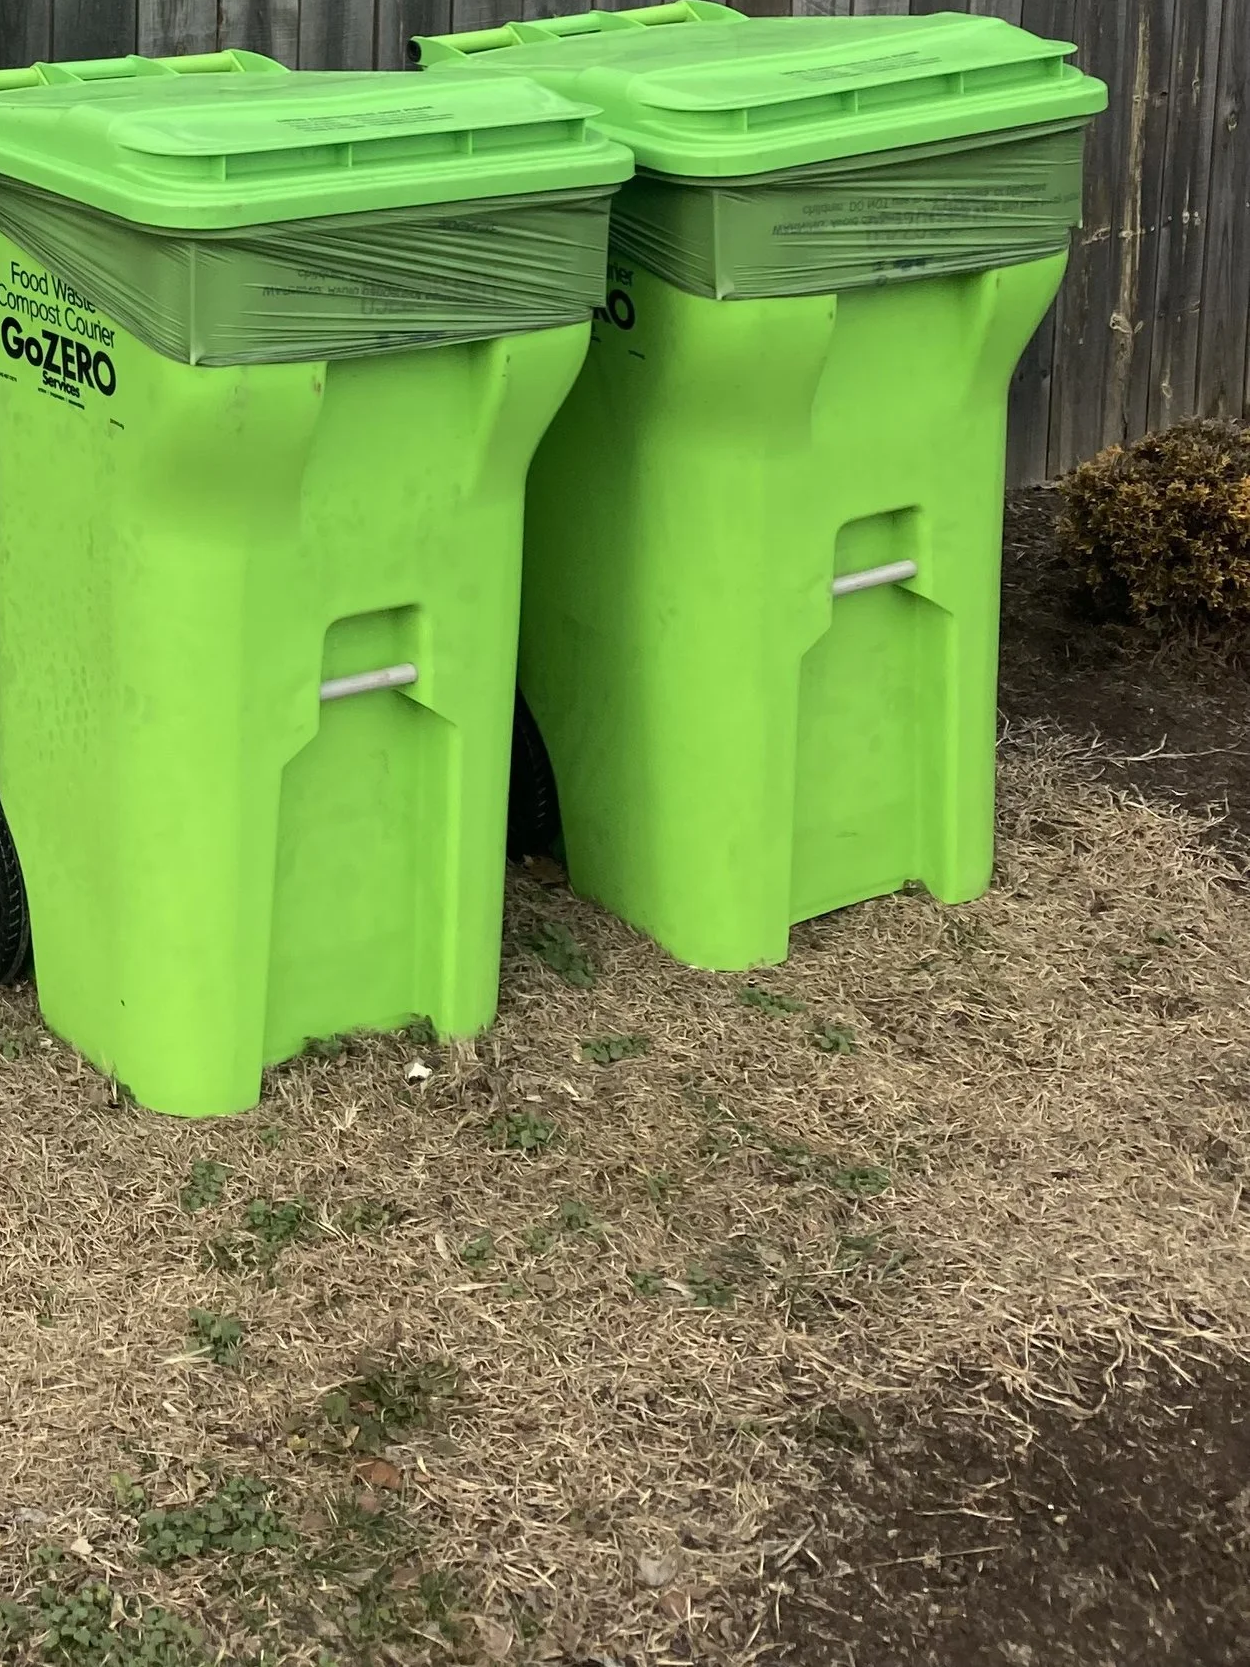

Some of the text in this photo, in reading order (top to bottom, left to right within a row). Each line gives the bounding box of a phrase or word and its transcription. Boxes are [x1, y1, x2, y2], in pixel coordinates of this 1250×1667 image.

[11, 261, 48, 296] Food
[65, 307, 115, 349] Courier
[1, 316, 116, 396] GoZERO
[42, 370, 80, 398] Services
